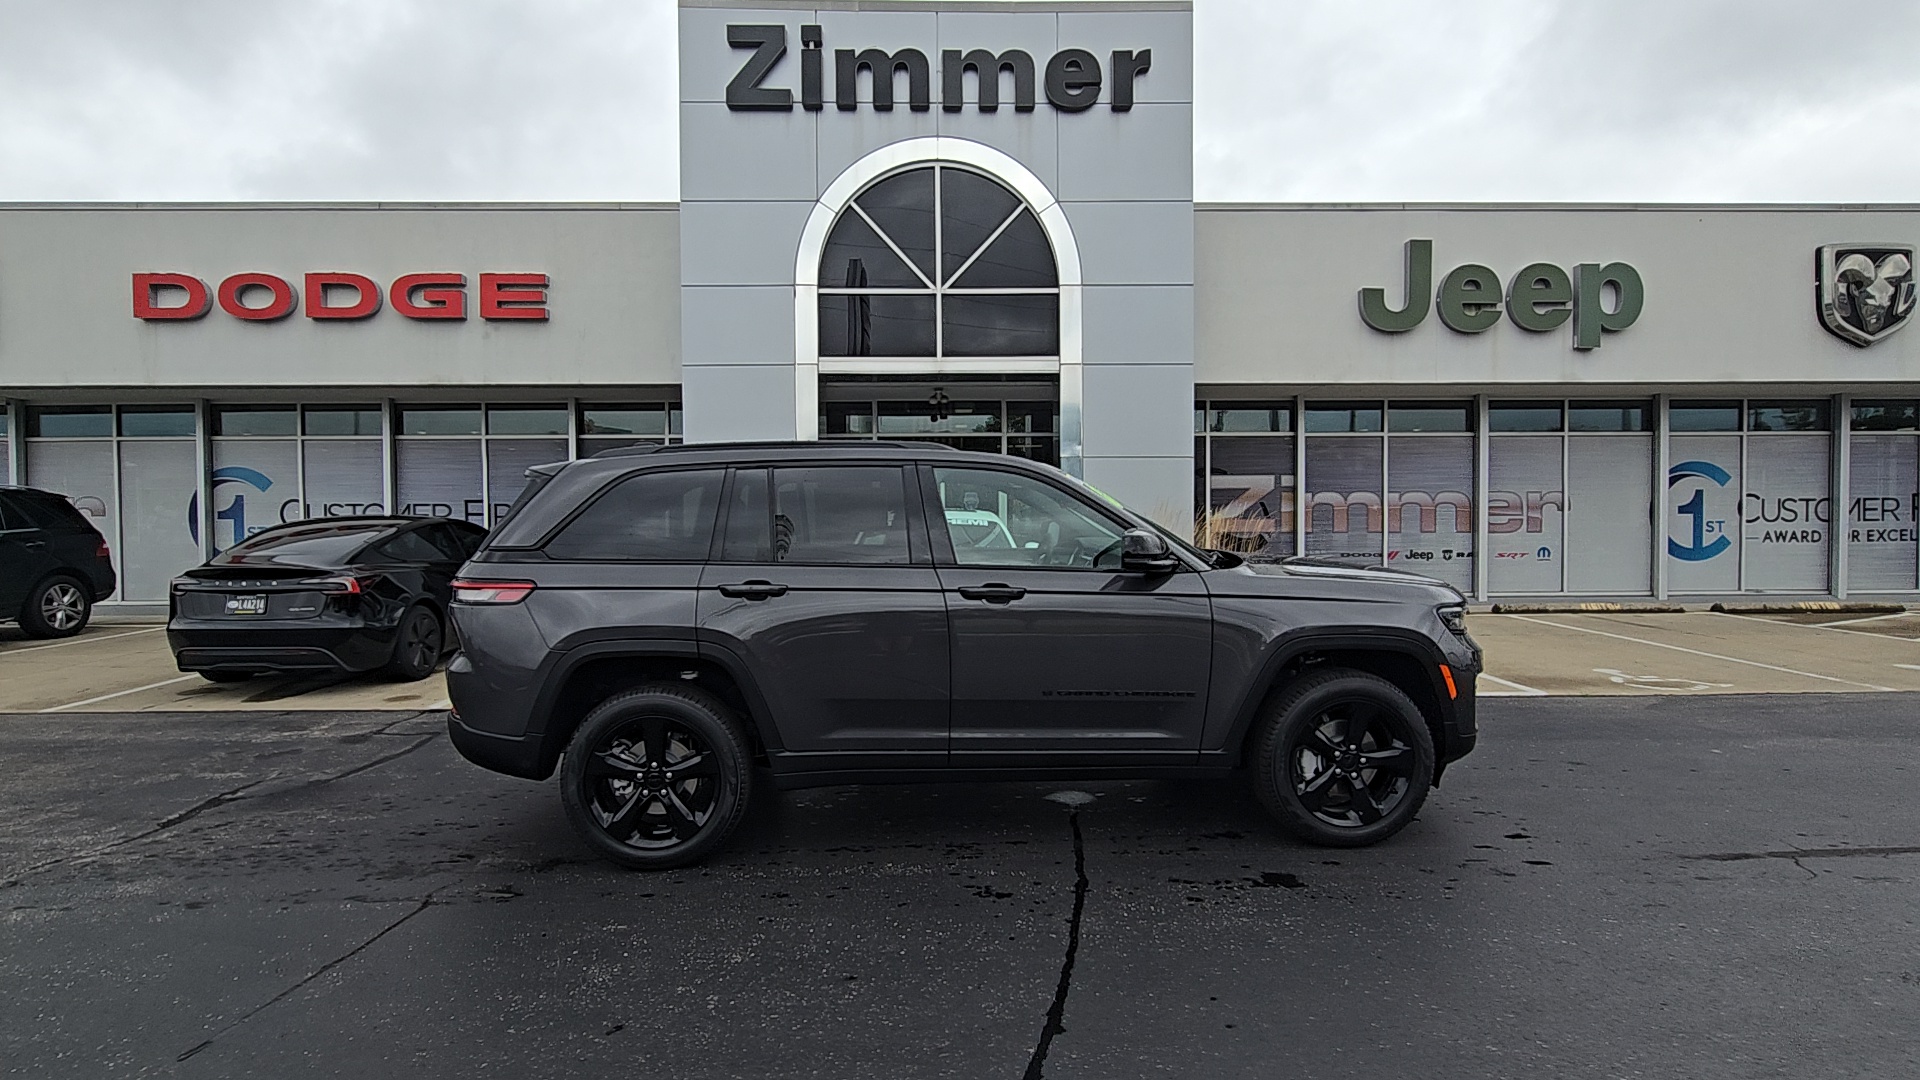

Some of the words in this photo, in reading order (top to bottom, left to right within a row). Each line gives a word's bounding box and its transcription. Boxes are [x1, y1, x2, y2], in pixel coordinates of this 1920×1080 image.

[726, 24, 1152, 112] Zimmer
[132, 272, 549, 321] DODGE
[1357, 239, 1644, 350] Jeep
[280, 499, 452, 523] CUSTER
[1207, 474, 1571, 534] Zimmer
[1762, 529, 1822, 543] AWARD
[1405, 549, 1434, 561] Jeep
[1494, 552, 1530, 560] SRT
